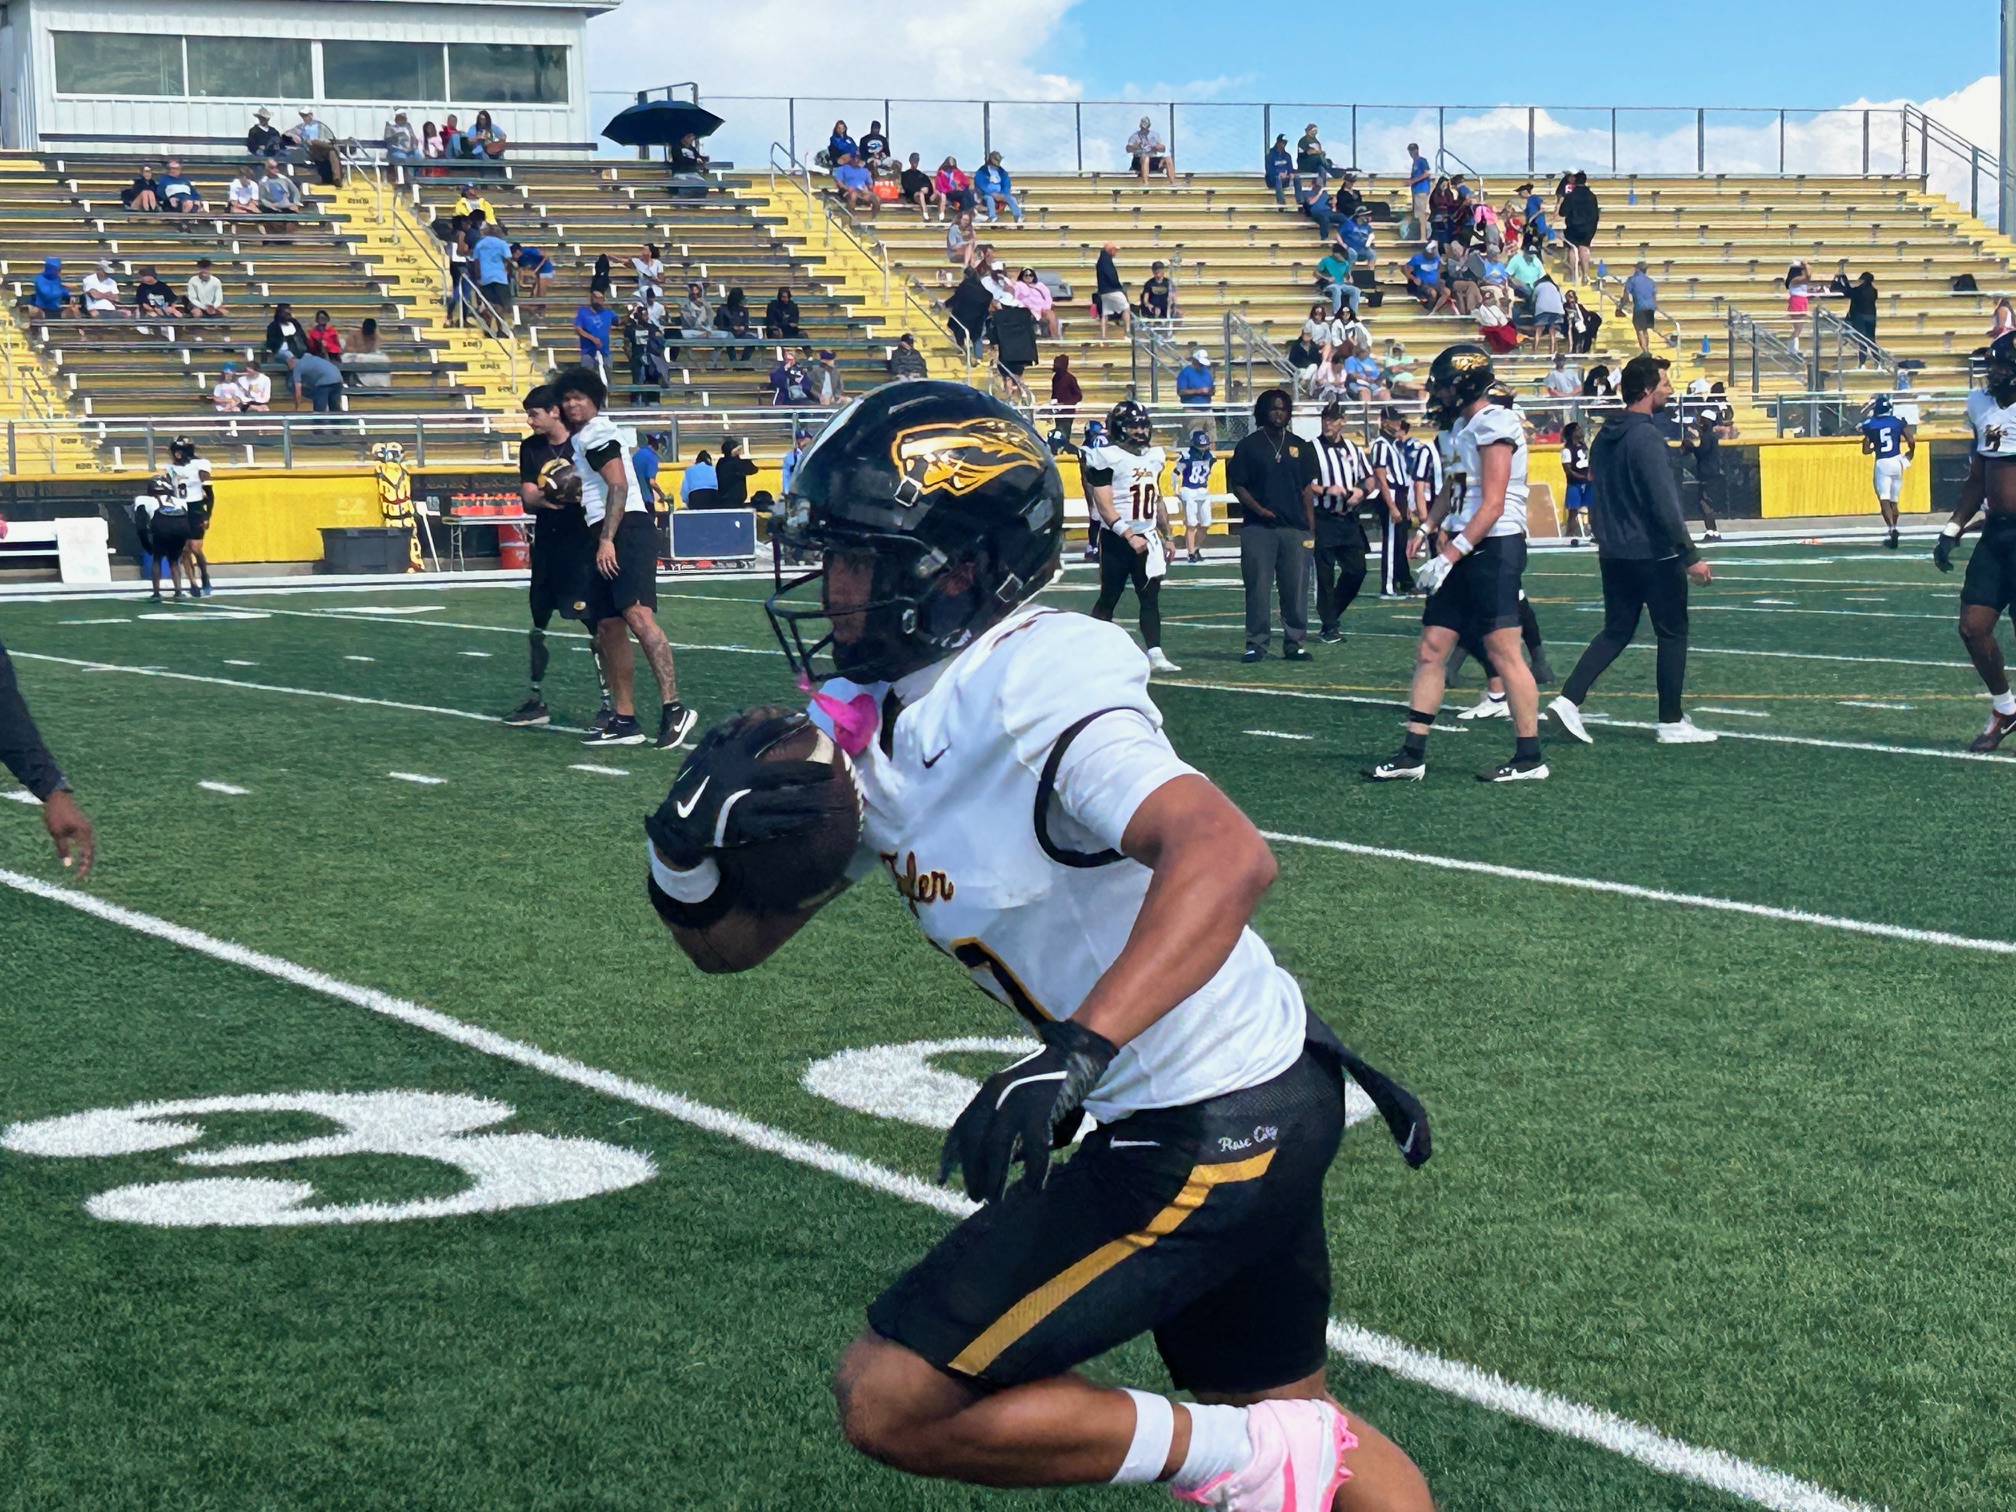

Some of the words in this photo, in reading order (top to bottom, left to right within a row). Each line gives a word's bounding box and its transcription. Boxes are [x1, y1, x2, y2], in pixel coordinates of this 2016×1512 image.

[1879, 427, 1894, 452] 5
[1129, 483, 1156, 521] 10
[0, 1090, 658, 1227] 3
[1217, 1136, 1253, 1153] Rose
